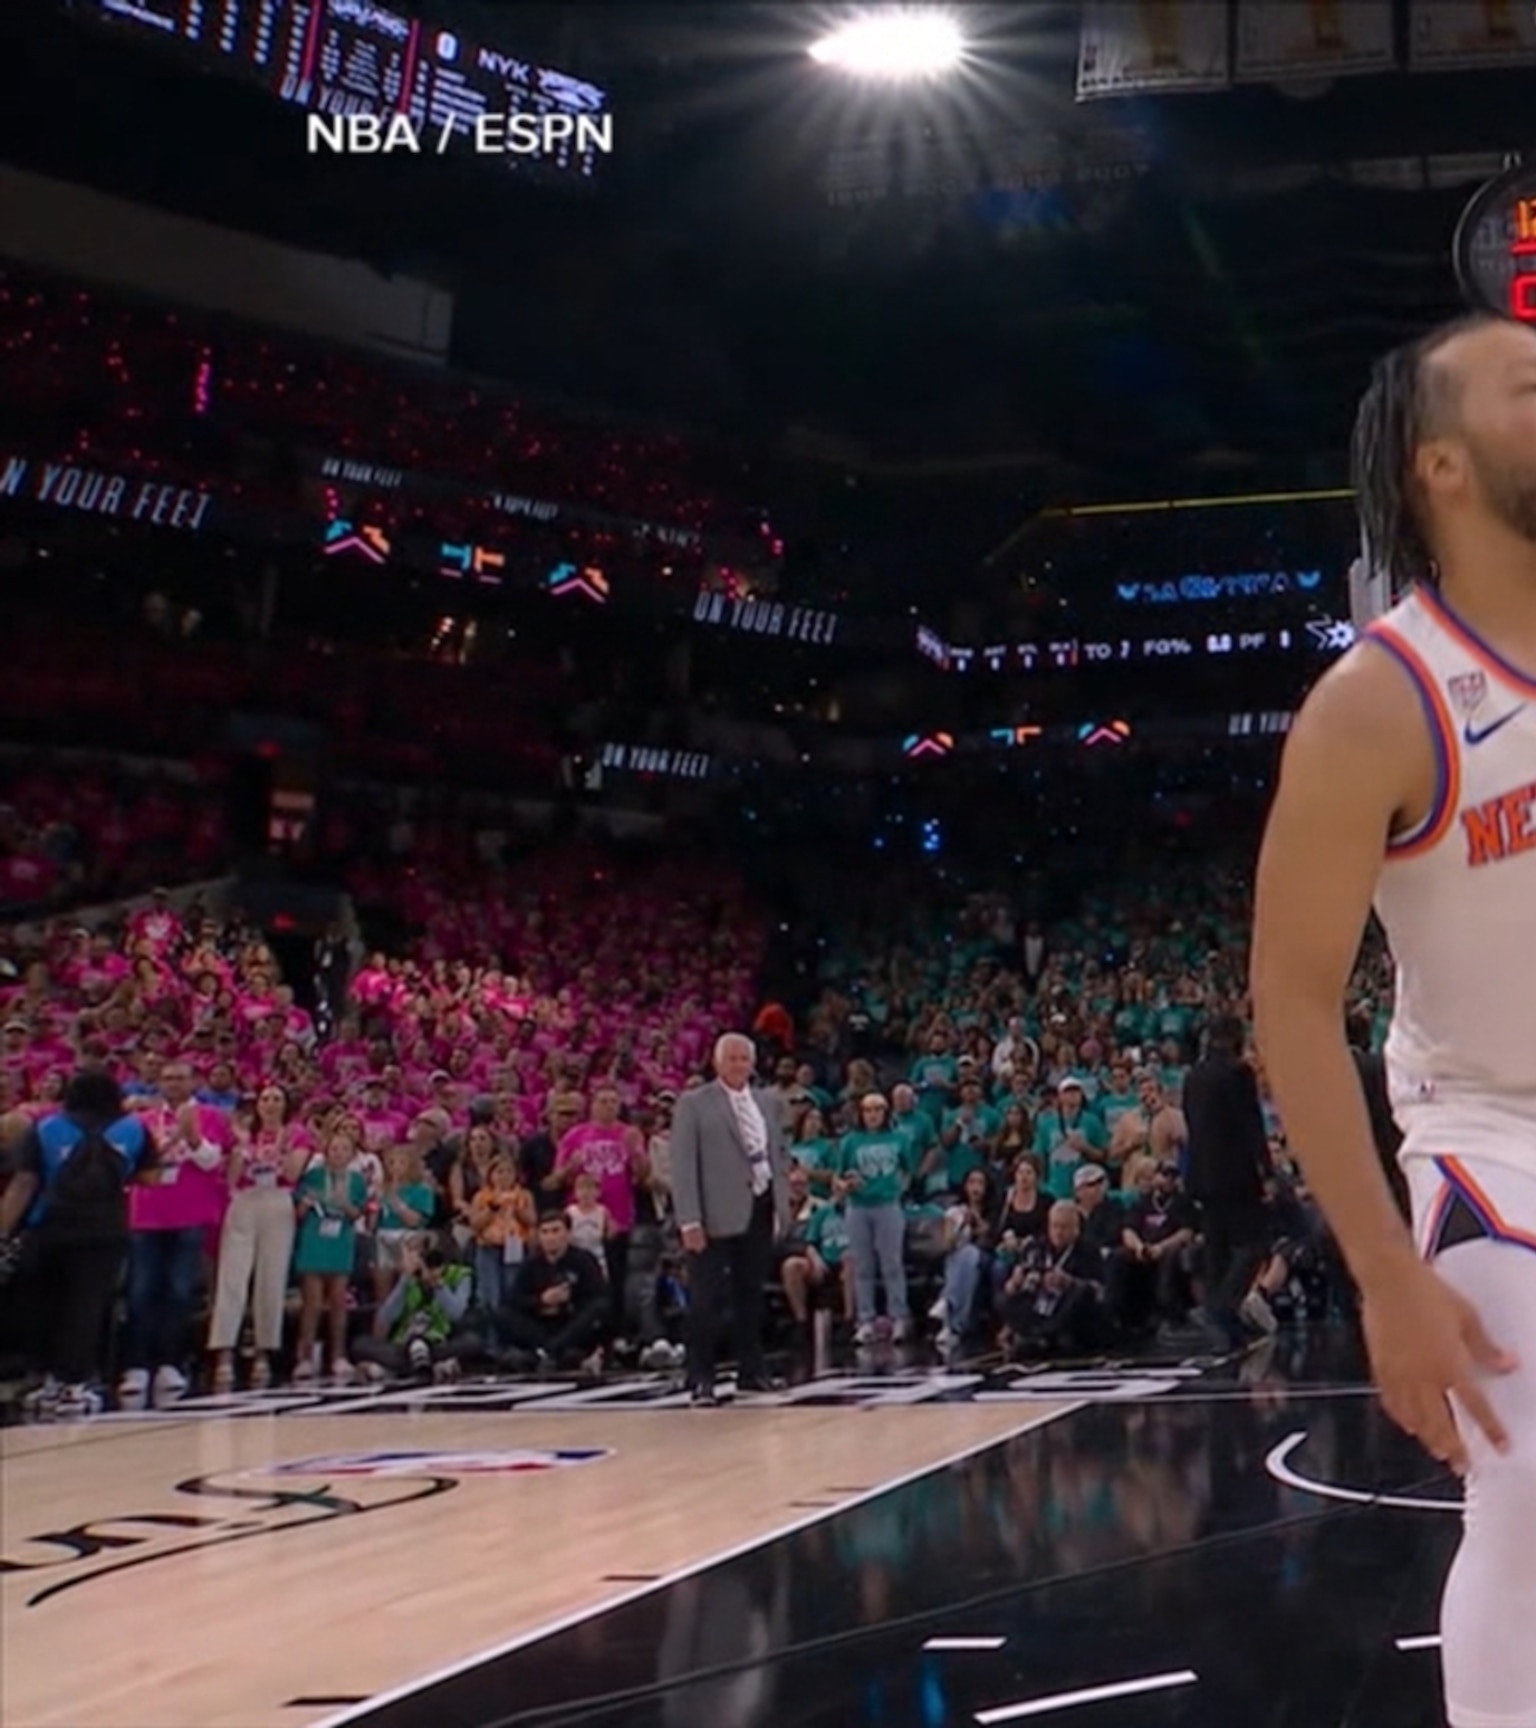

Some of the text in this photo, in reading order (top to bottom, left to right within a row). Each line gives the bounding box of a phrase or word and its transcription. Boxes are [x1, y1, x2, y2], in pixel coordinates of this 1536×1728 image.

[478, 48, 529, 83] NYK
[0, 457, 210, 529] N YOUR FEET
[1085, 643, 1112, 660] TO
[1239, 632, 1266, 649] PF
